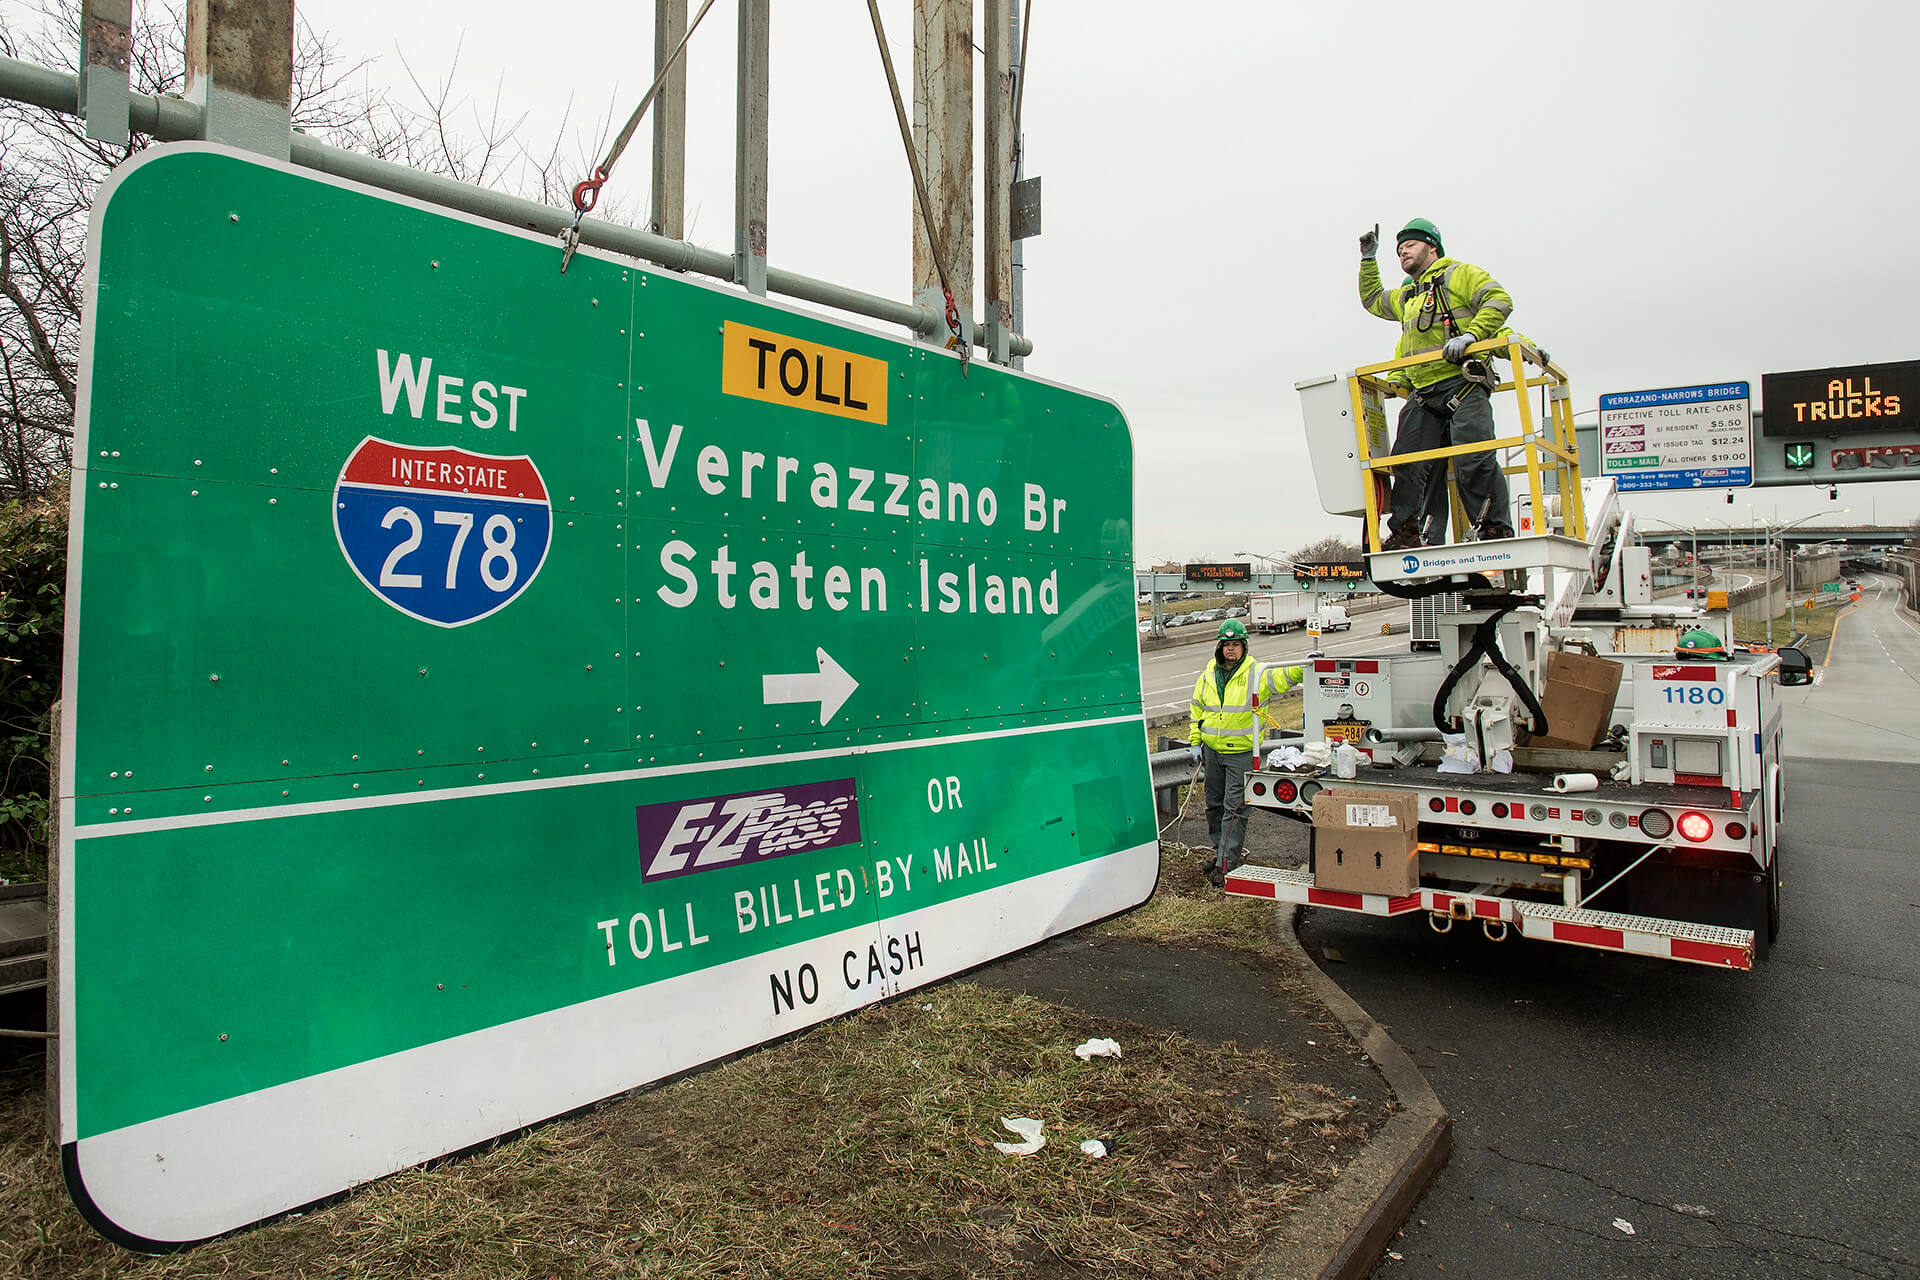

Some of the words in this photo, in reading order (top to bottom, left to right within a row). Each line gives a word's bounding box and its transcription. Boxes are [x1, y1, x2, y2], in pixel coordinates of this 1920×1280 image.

[748, 338, 868, 411] TOLL
[1828, 376, 1881, 399] ALL
[376, 348, 527, 432] WEST
[1607, 390, 1703, 405] VERRAZANO-NARROWS
[1708, 386, 1741, 397] BRIDGE
[1606, 410, 1653, 422] EFFECTIVE
[1659, 408, 1680, 417] TOLL
[1686, 403, 1742, 415] RATE-CARS
[1793, 395, 1901, 422] TRUCKS
[1665, 424, 1699, 432] RESIDENT
[1711, 418, 1741, 428] $5.50
[1663, 440, 1689, 448] ISSUED
[1711, 436, 1744, 446] $12.24
[1680, 455, 1707, 463] OTHERS
[1711, 453, 1746, 462] $19.00
[391, 457, 508, 489] INTERSTATE
[635, 418, 998, 527] Verrazzano
[1024, 482, 1067, 534] Br
[379, 506, 518, 593] 278
[1423, 557, 1456, 567] Bridges
[1459, 556, 1475, 564] and
[1476, 553, 1511, 562] Tunnels
[656, 539, 887, 612] Staten
[919, 558, 1059, 616] Island
[1308, 622, 1320, 630] 45
[1662, 686, 1725, 705] 1180
[927, 775, 963, 814] OR
[597, 902, 710, 967] TOLL
[733, 868, 857, 934] BILLED
[875, 853, 914, 899] BY
[933, 837, 998, 883] MAIL
[769, 962, 820, 1016] NO
[842, 930, 925, 991] CASH
